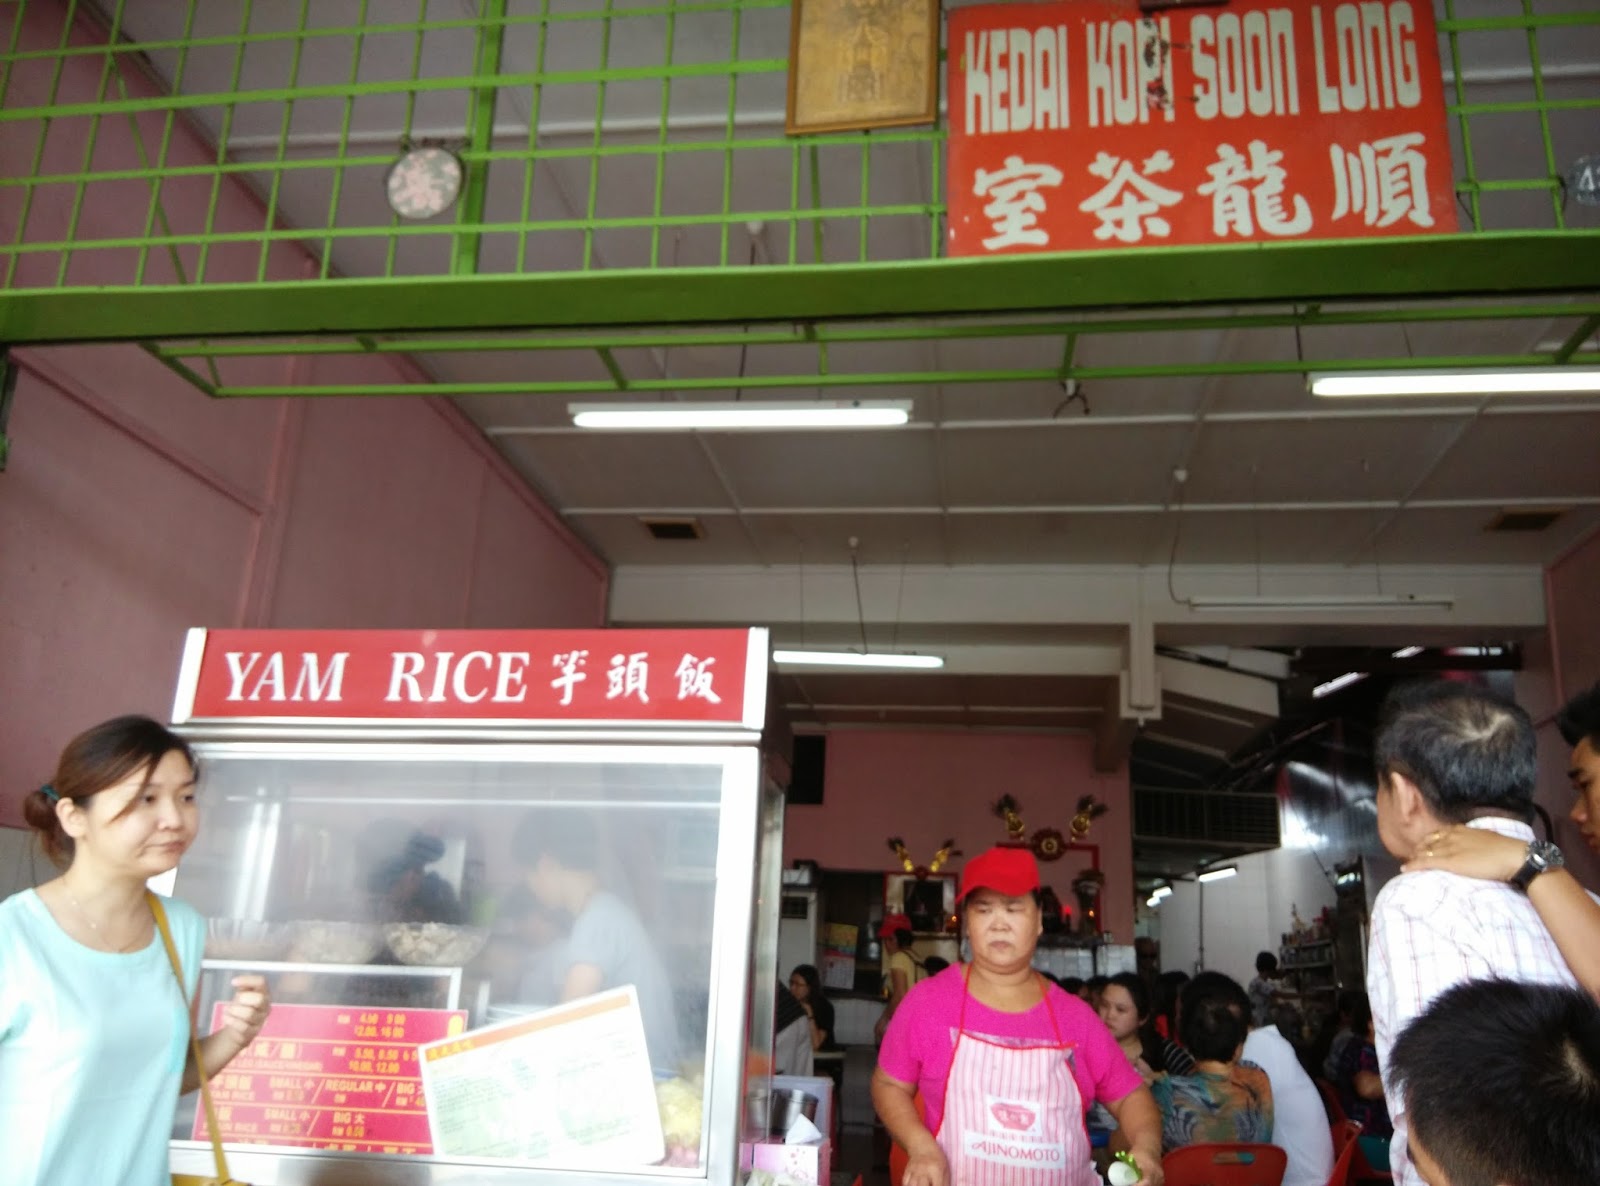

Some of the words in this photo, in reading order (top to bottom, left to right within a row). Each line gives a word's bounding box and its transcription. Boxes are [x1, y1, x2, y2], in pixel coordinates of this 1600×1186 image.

[964, 25, 1070, 134] KEDAI
[1086, 17, 1174, 127] KOPI
[1190, 10, 1299, 119] SOON
[1311, 1, 1420, 114] LONG
[224, 652, 351, 702] YAM
[384, 651, 531, 704] RICE
[972, 1140, 1060, 1162] AJINOMOTO
